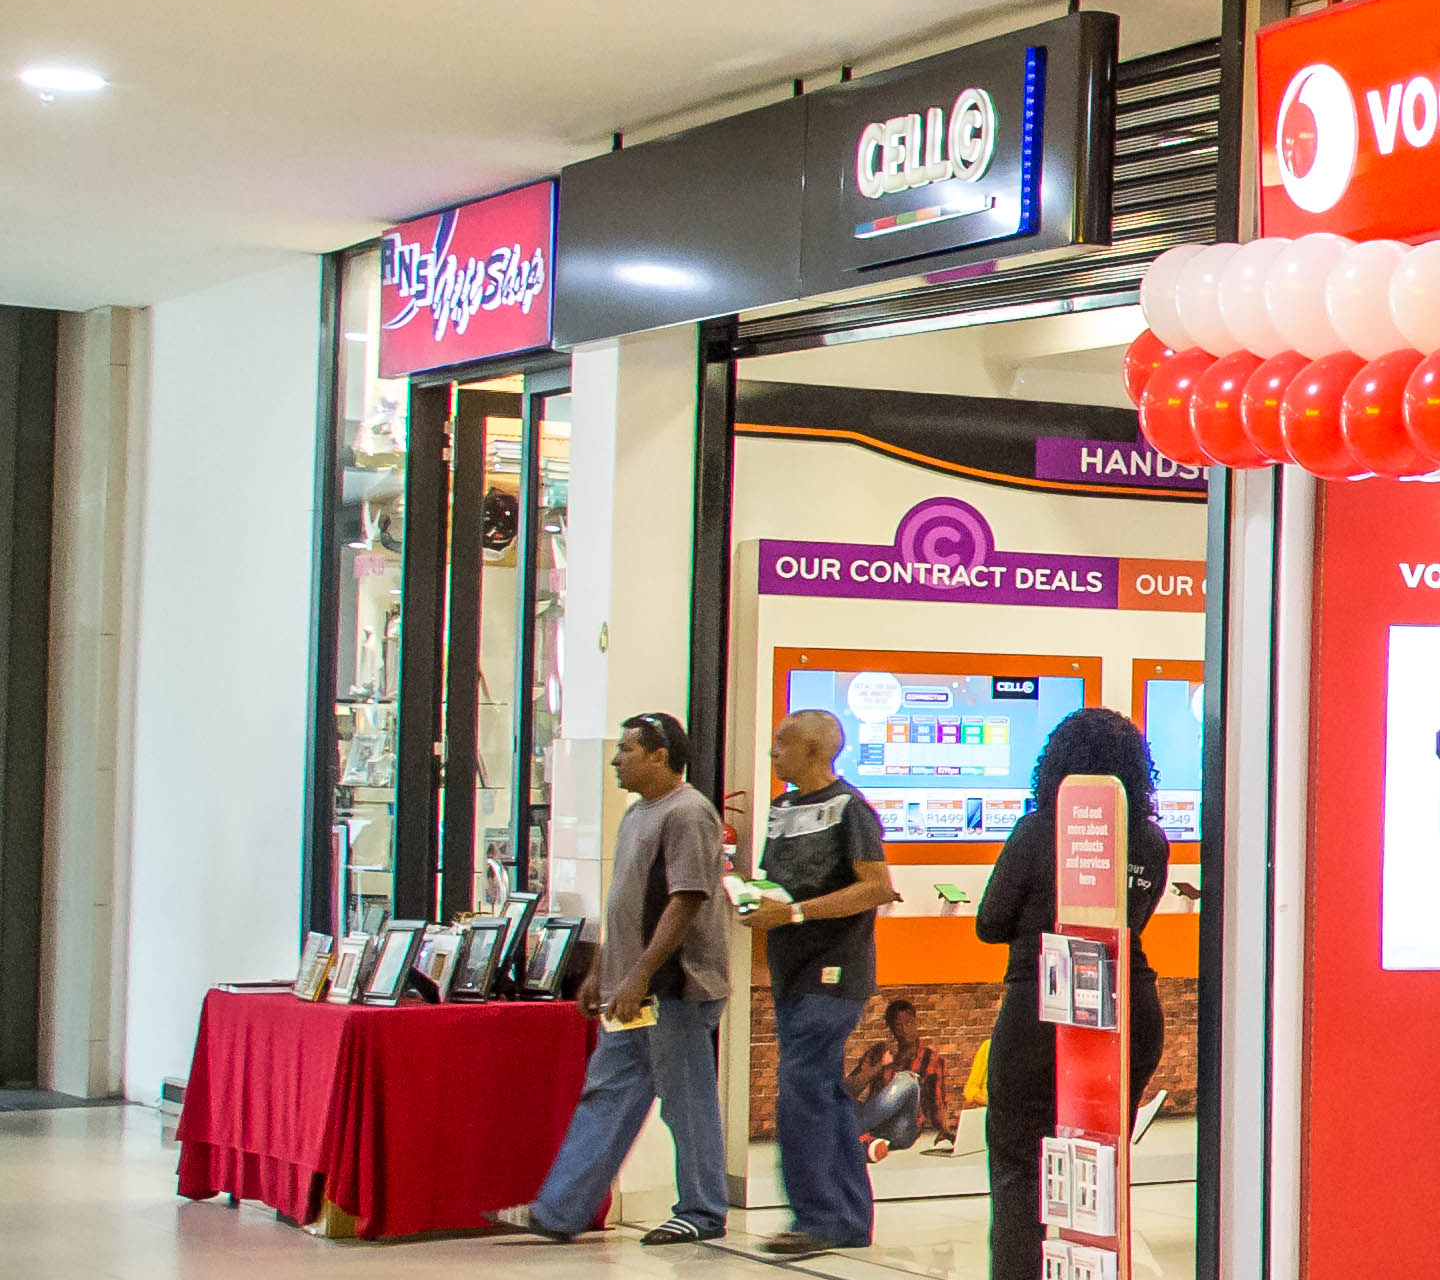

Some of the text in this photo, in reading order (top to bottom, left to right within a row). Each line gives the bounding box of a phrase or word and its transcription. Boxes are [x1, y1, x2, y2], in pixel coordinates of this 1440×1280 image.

[1080, 447, 1208, 482] HANDS
[775, 556, 1104, 593] OUR CONTRACT DEALS
[1135, 574, 1193, 597] OUR
[1072, 805, 1102, 819] Find out
[1067, 824, 1108, 836] more about
[1071, 840, 1104, 854] products
[1065, 857, 1111, 869] and services
[1079, 873, 1097, 886] here
